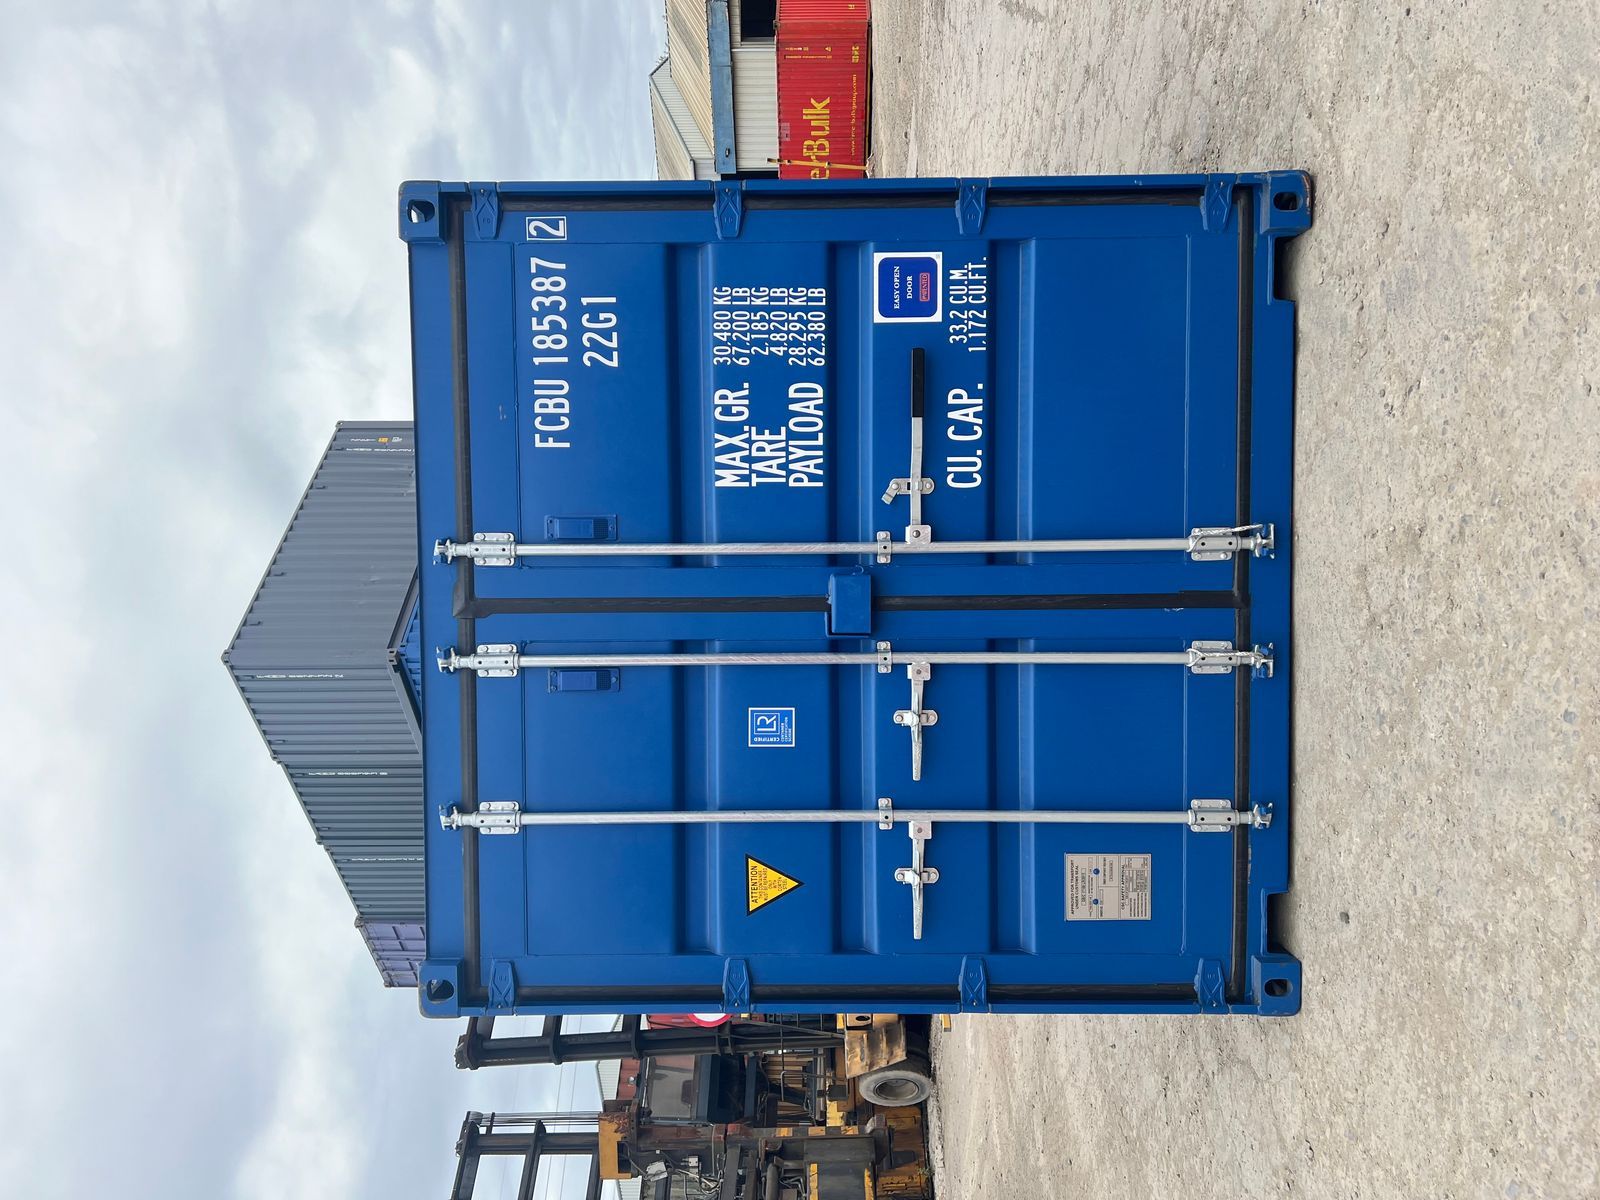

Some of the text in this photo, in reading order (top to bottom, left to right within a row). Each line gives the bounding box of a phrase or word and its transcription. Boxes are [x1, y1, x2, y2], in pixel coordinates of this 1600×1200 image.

[713, 286, 731, 305] KG
[732, 287, 751, 366] 67,200 LB
[770, 287, 789, 356] 4,820 LB
[807, 287, 827, 367] 62,380 LB
[949, 310, 968, 344] 33.2
[528, 220, 571, 448] FCBU 185387 2
[580, 296, 619, 367] 22G1
[713, 310, 732, 366] 30,480
[968, 310, 987, 352] 1,172
[751, 286, 786, 487] TARE 2,185 KG
[788, 287, 824, 487] PAYLOAD 28,295 KG
[947, 383, 983, 441] CAP.
[947, 450, 983, 489] CU.
